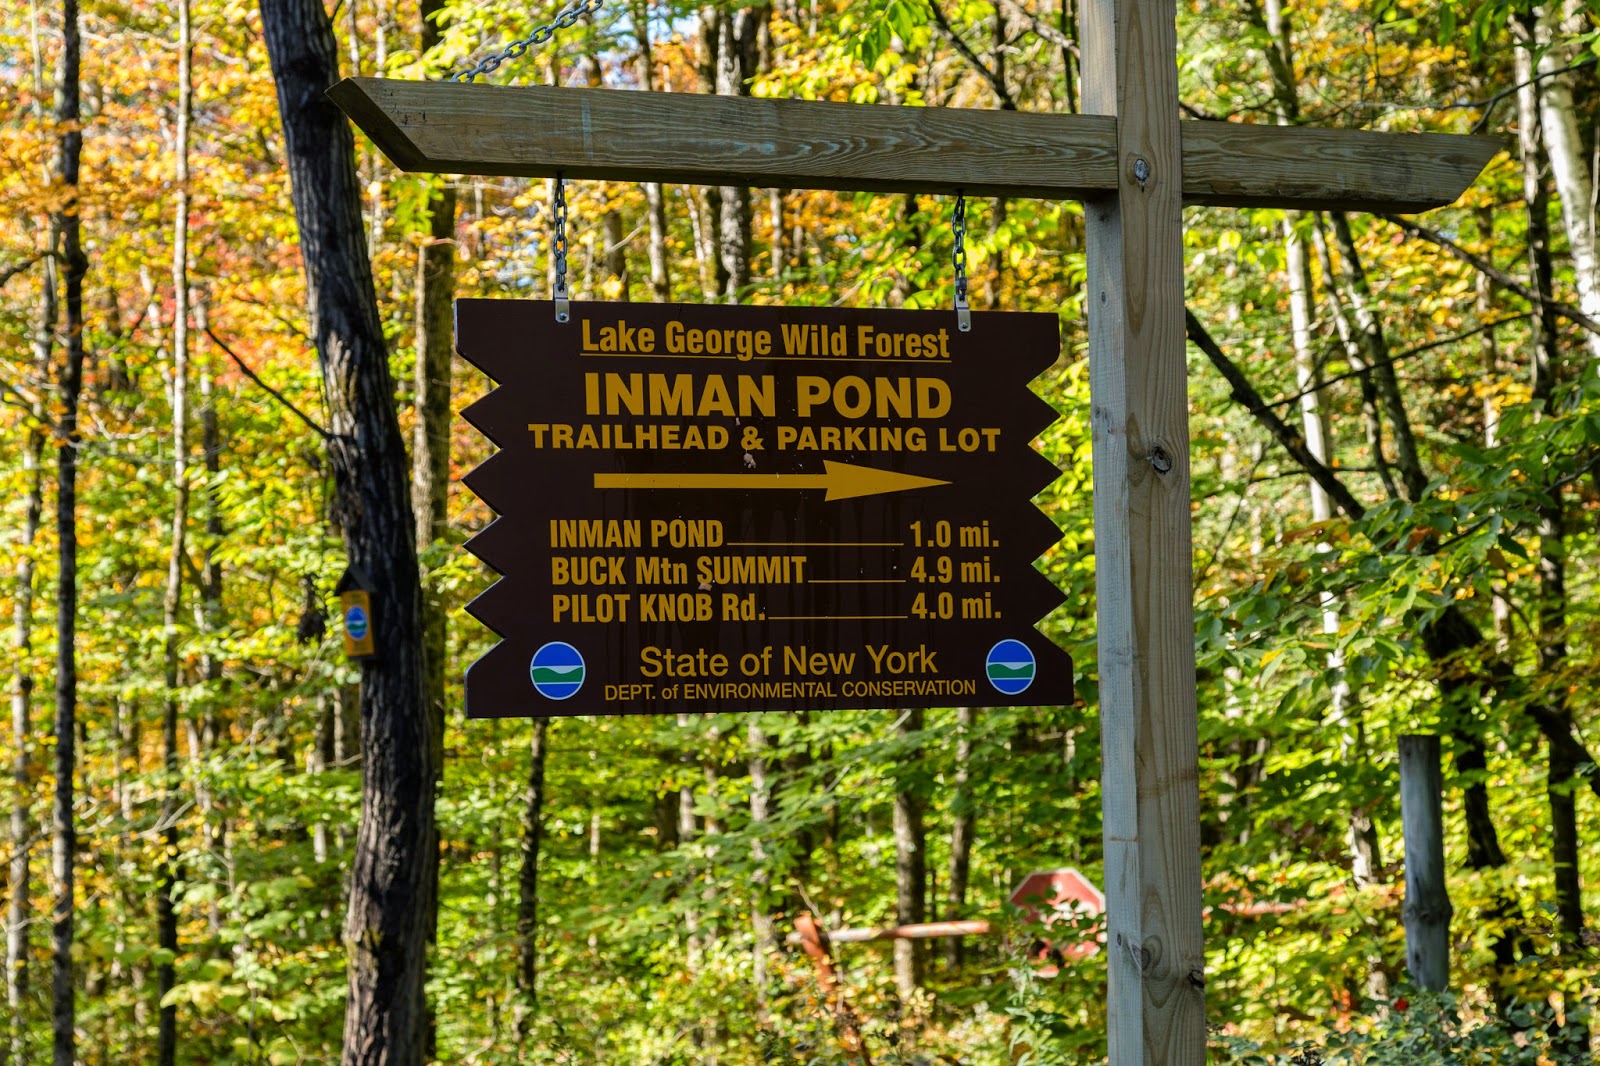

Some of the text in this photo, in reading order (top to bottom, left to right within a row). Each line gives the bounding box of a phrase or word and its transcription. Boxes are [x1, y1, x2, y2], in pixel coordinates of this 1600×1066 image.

[582, 319, 949, 361] Lake George Wild Forest
[585, 373, 951, 418] INMAN POND
[528, 424, 1000, 452] TRAILHEAD & PARKING LOT
[550, 519, 999, 548] INMAN POND 1.0 mi.
[552, 556, 1000, 585] BUCK Mtn SUMMIT 4.9 mi.
[553, 592, 1001, 623] PILOT KNOB Rd. 4.0 mi.
[640, 644, 938, 677] State of New York
[605, 680, 976, 700] DEPT. of ENVIRONMENTAL CONSERVATION
